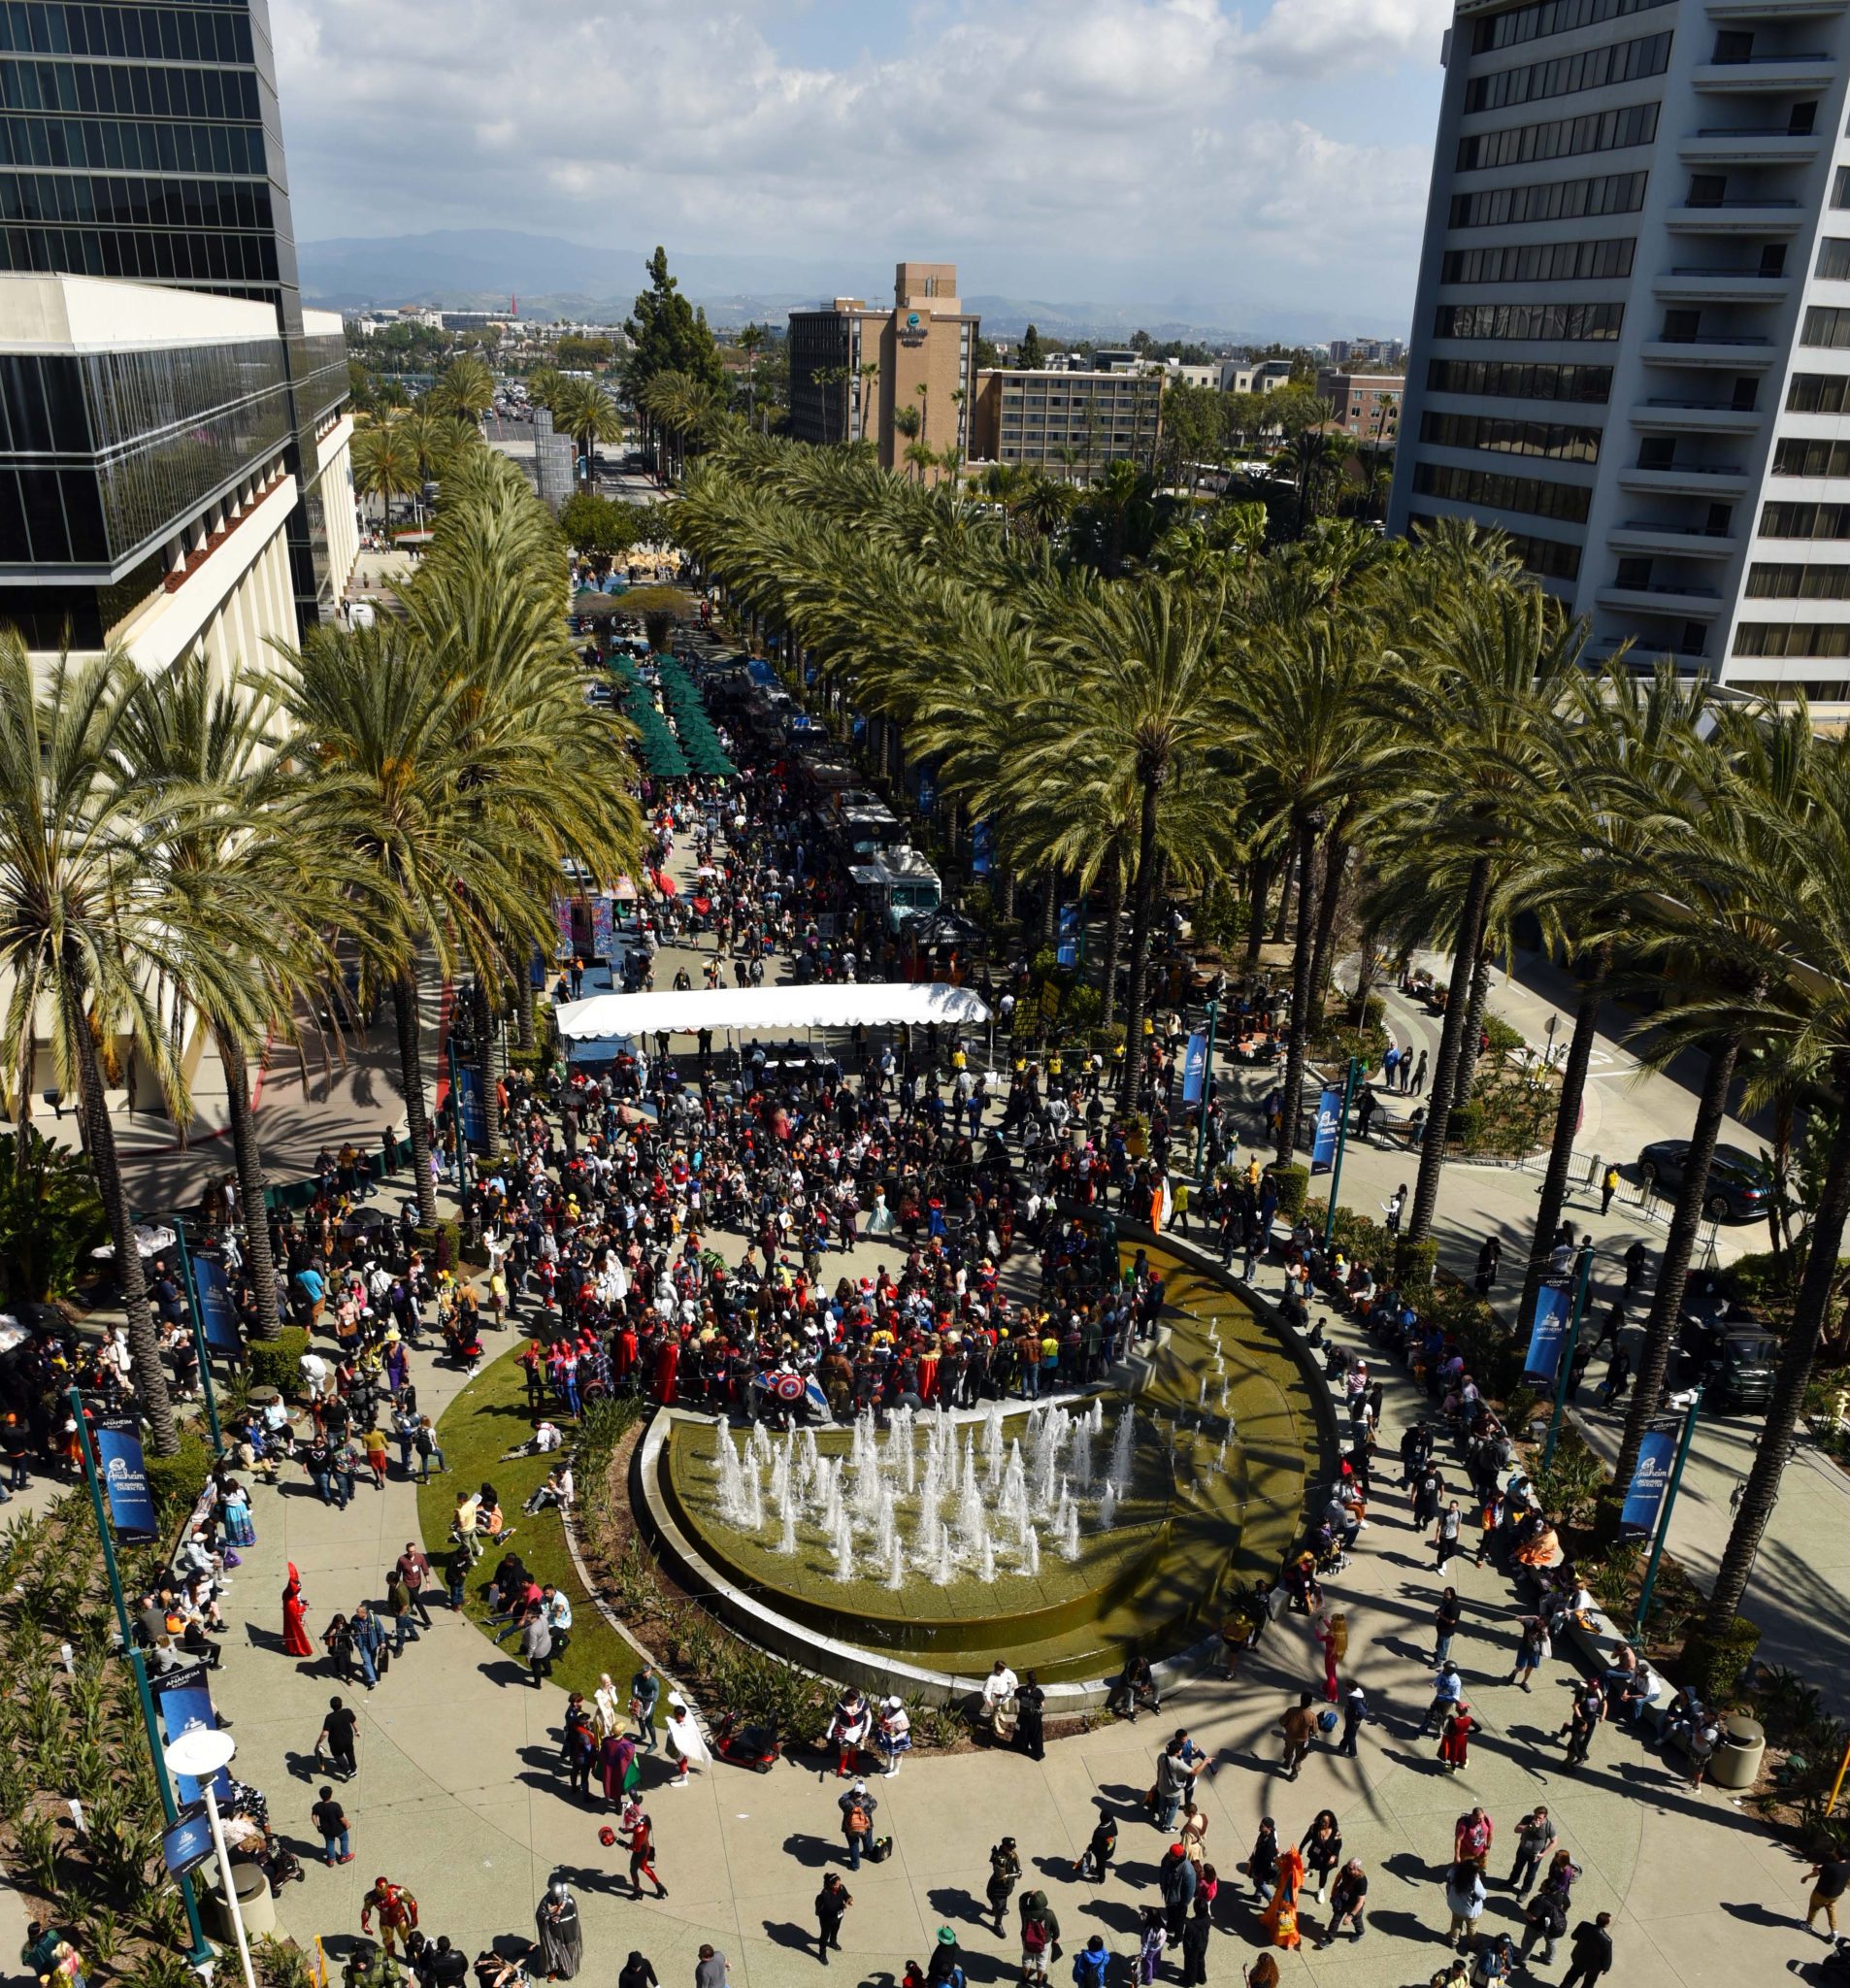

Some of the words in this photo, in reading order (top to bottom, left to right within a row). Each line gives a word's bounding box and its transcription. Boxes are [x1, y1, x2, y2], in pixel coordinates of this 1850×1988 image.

[107, 1467, 146, 1482] Anaheim
[1634, 1465, 1668, 1479] Anaheim
[166, 1670, 200, 1687] ANAHEIM
[171, 1679, 189, 1689] RESORT
